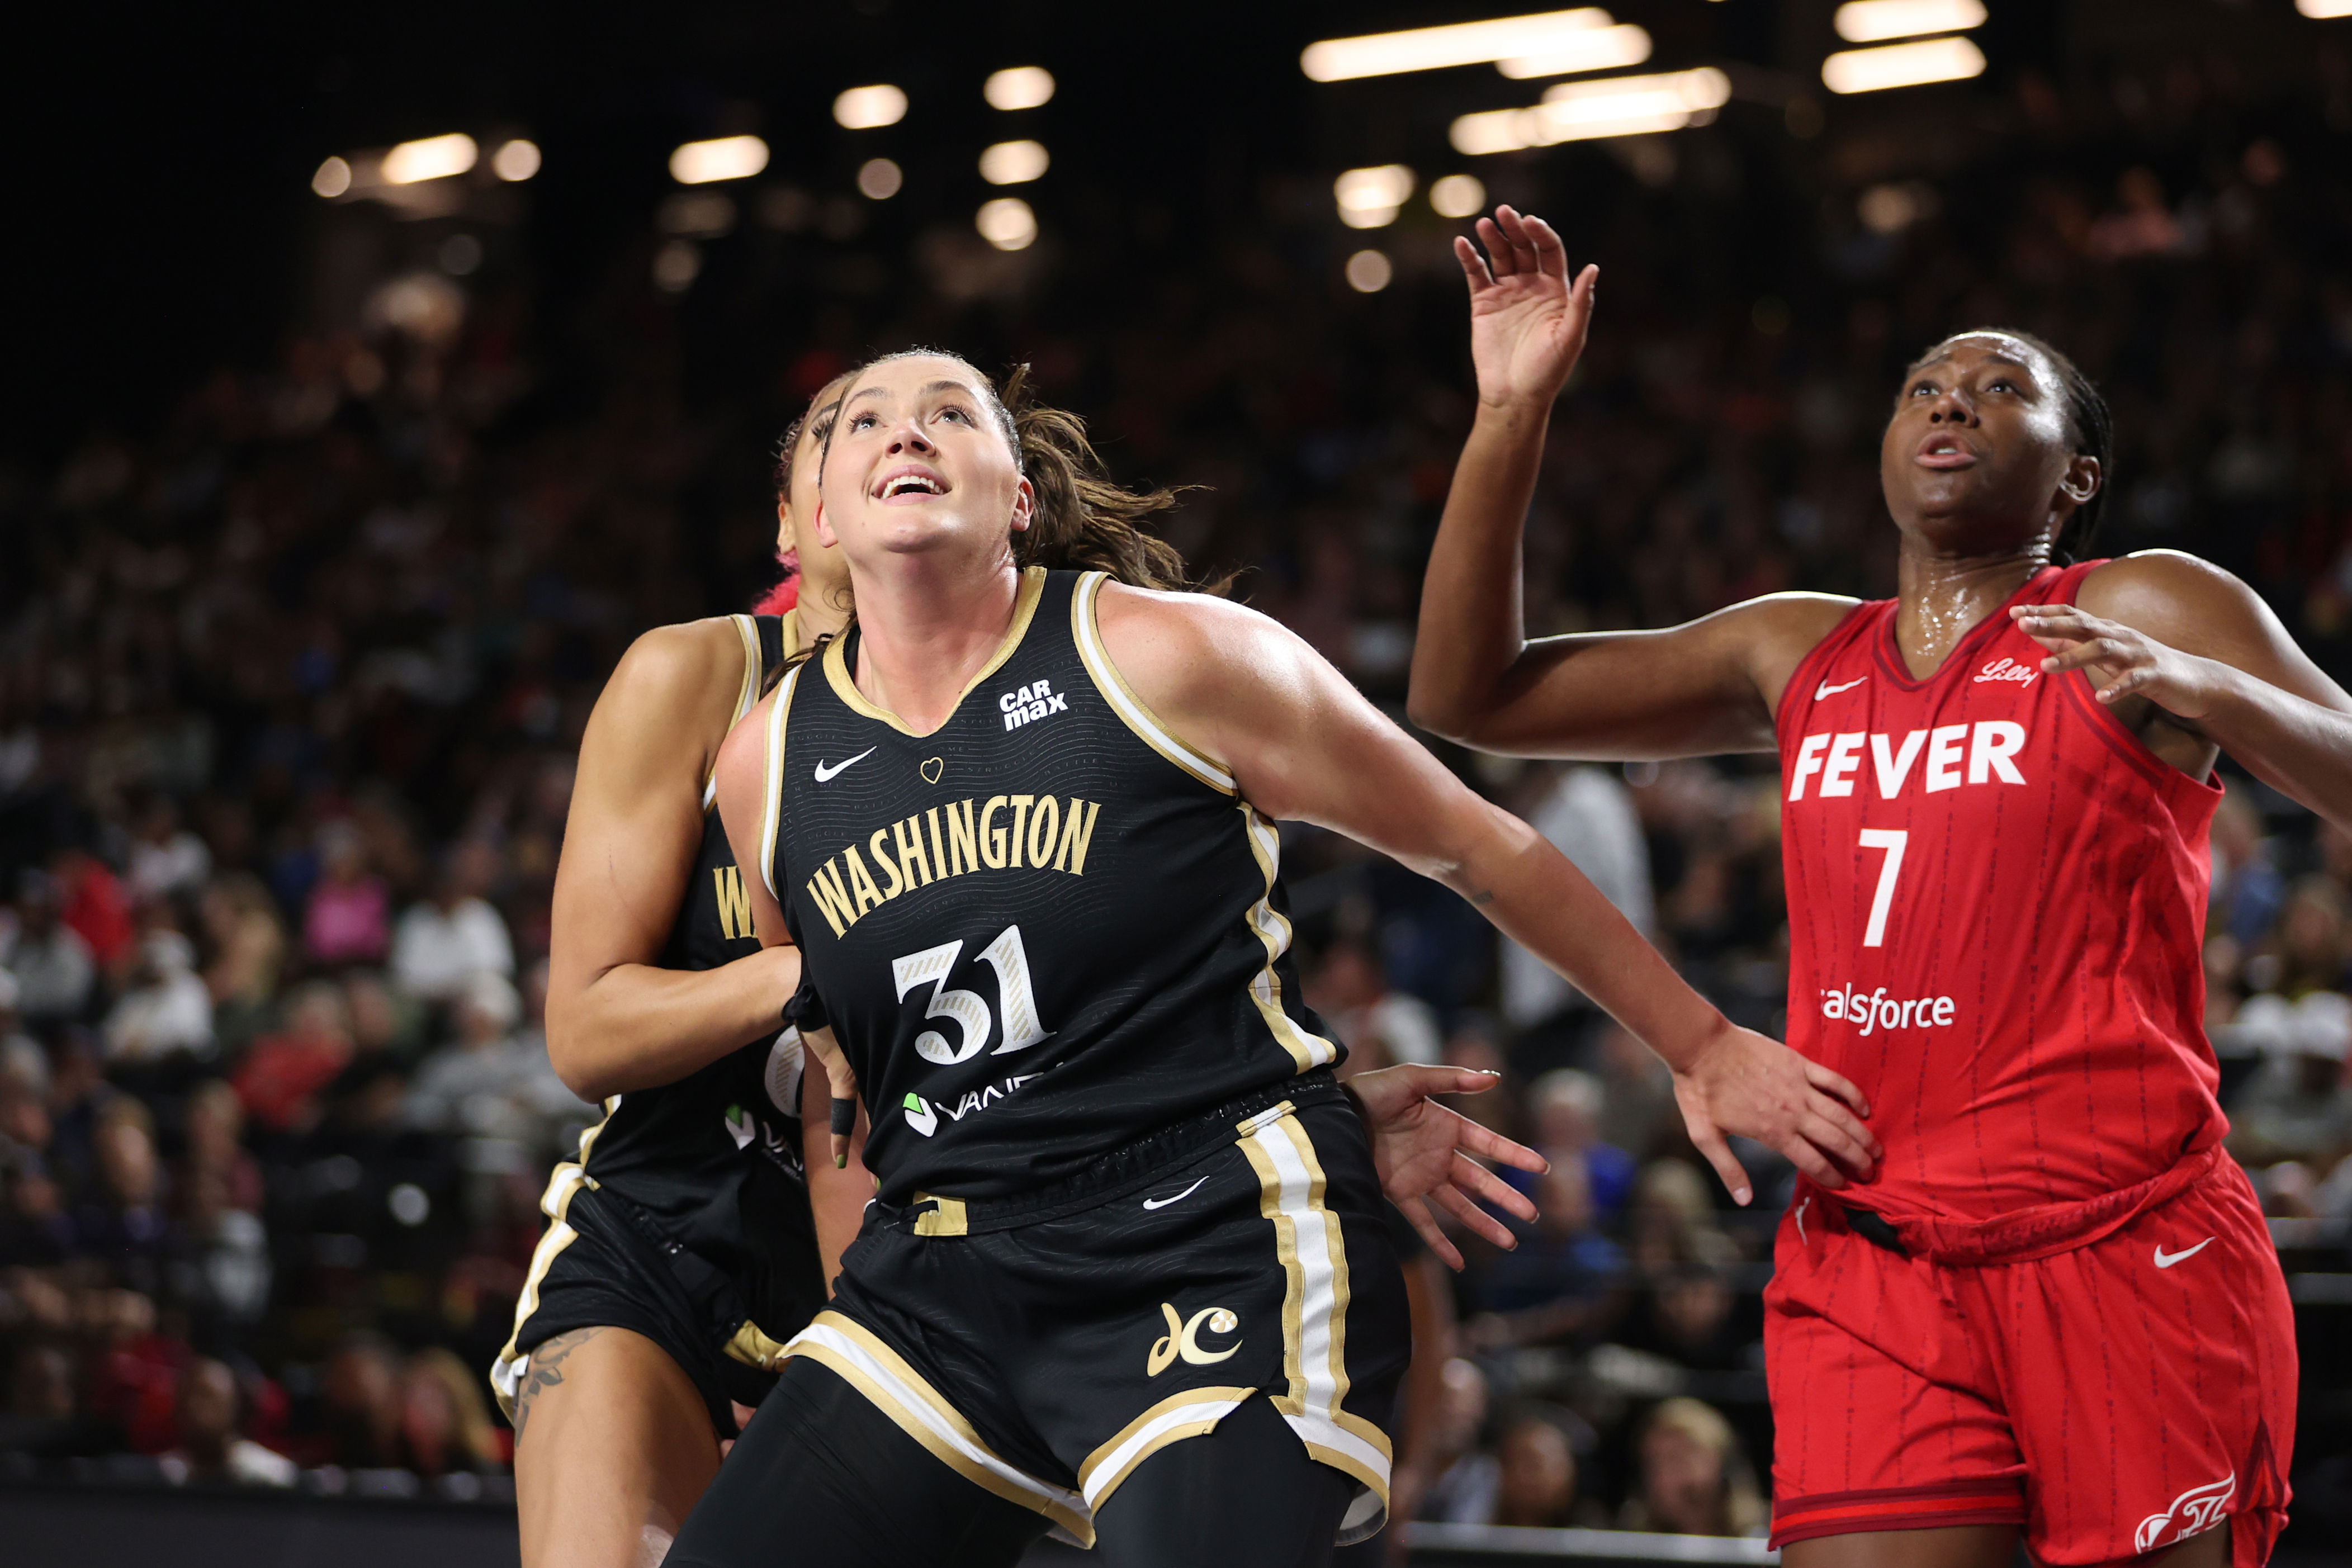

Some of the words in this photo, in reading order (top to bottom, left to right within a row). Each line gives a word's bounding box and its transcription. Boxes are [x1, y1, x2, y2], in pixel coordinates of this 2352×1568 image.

[999, 679, 1052, 713] CAR
[1973, 657, 2039, 688] Lilly
[1004, 692, 1069, 732] max
[1788, 719, 2027, 802] FEVER
[807, 794, 1101, 940] WASHINGTON
[1858, 828, 1908, 948] 7
[892, 924, 1057, 1065] 31
[1820, 982, 1955, 1037] alsforce
